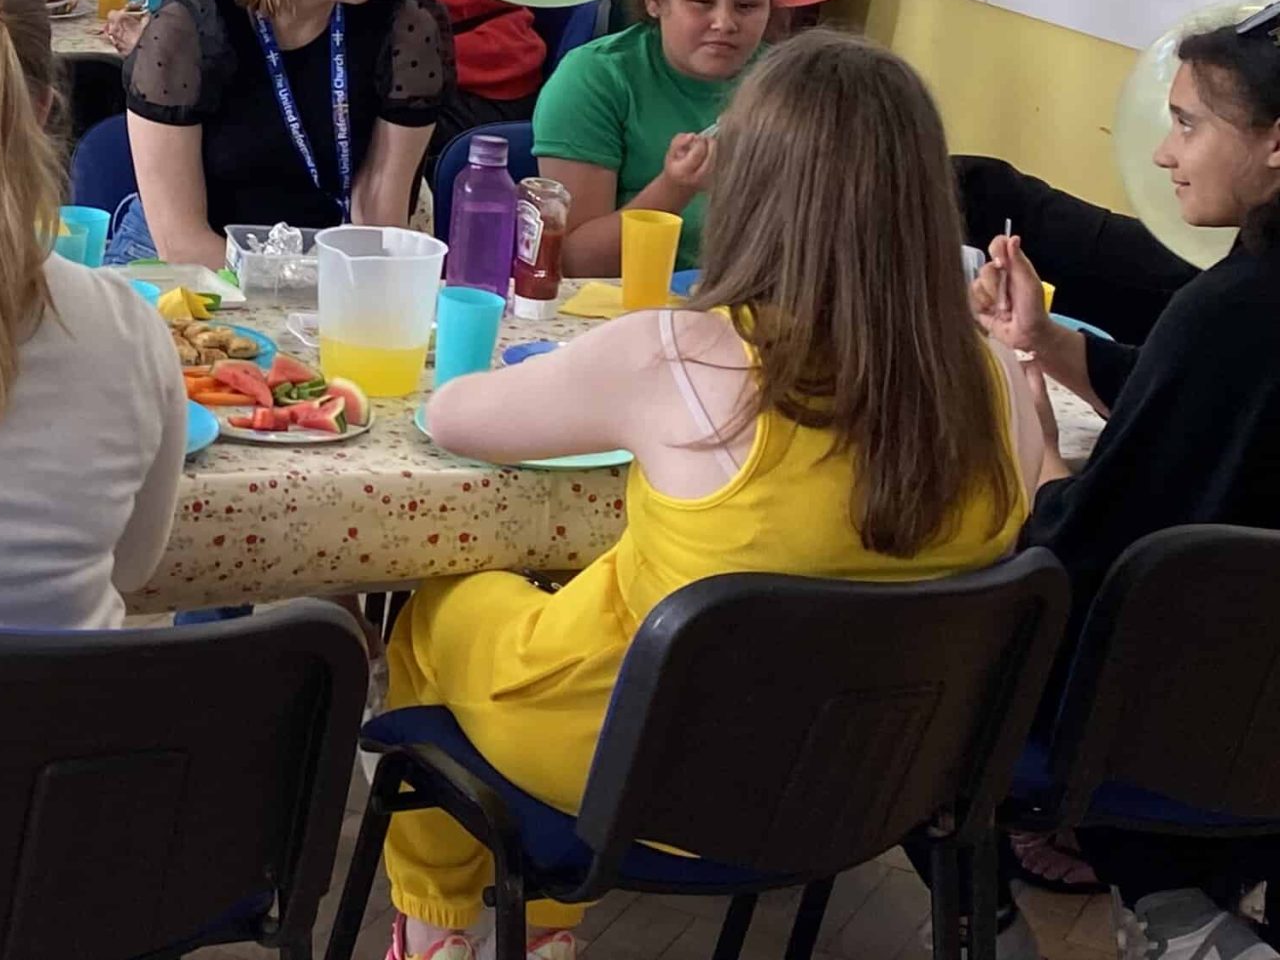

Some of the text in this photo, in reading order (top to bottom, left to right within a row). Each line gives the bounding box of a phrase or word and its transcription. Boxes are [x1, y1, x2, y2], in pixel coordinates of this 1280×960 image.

[332, 53, 345, 89] Church
[279, 89, 297, 122] United
[289, 121, 315, 168] Reformed
[339, 141, 350, 174] United
